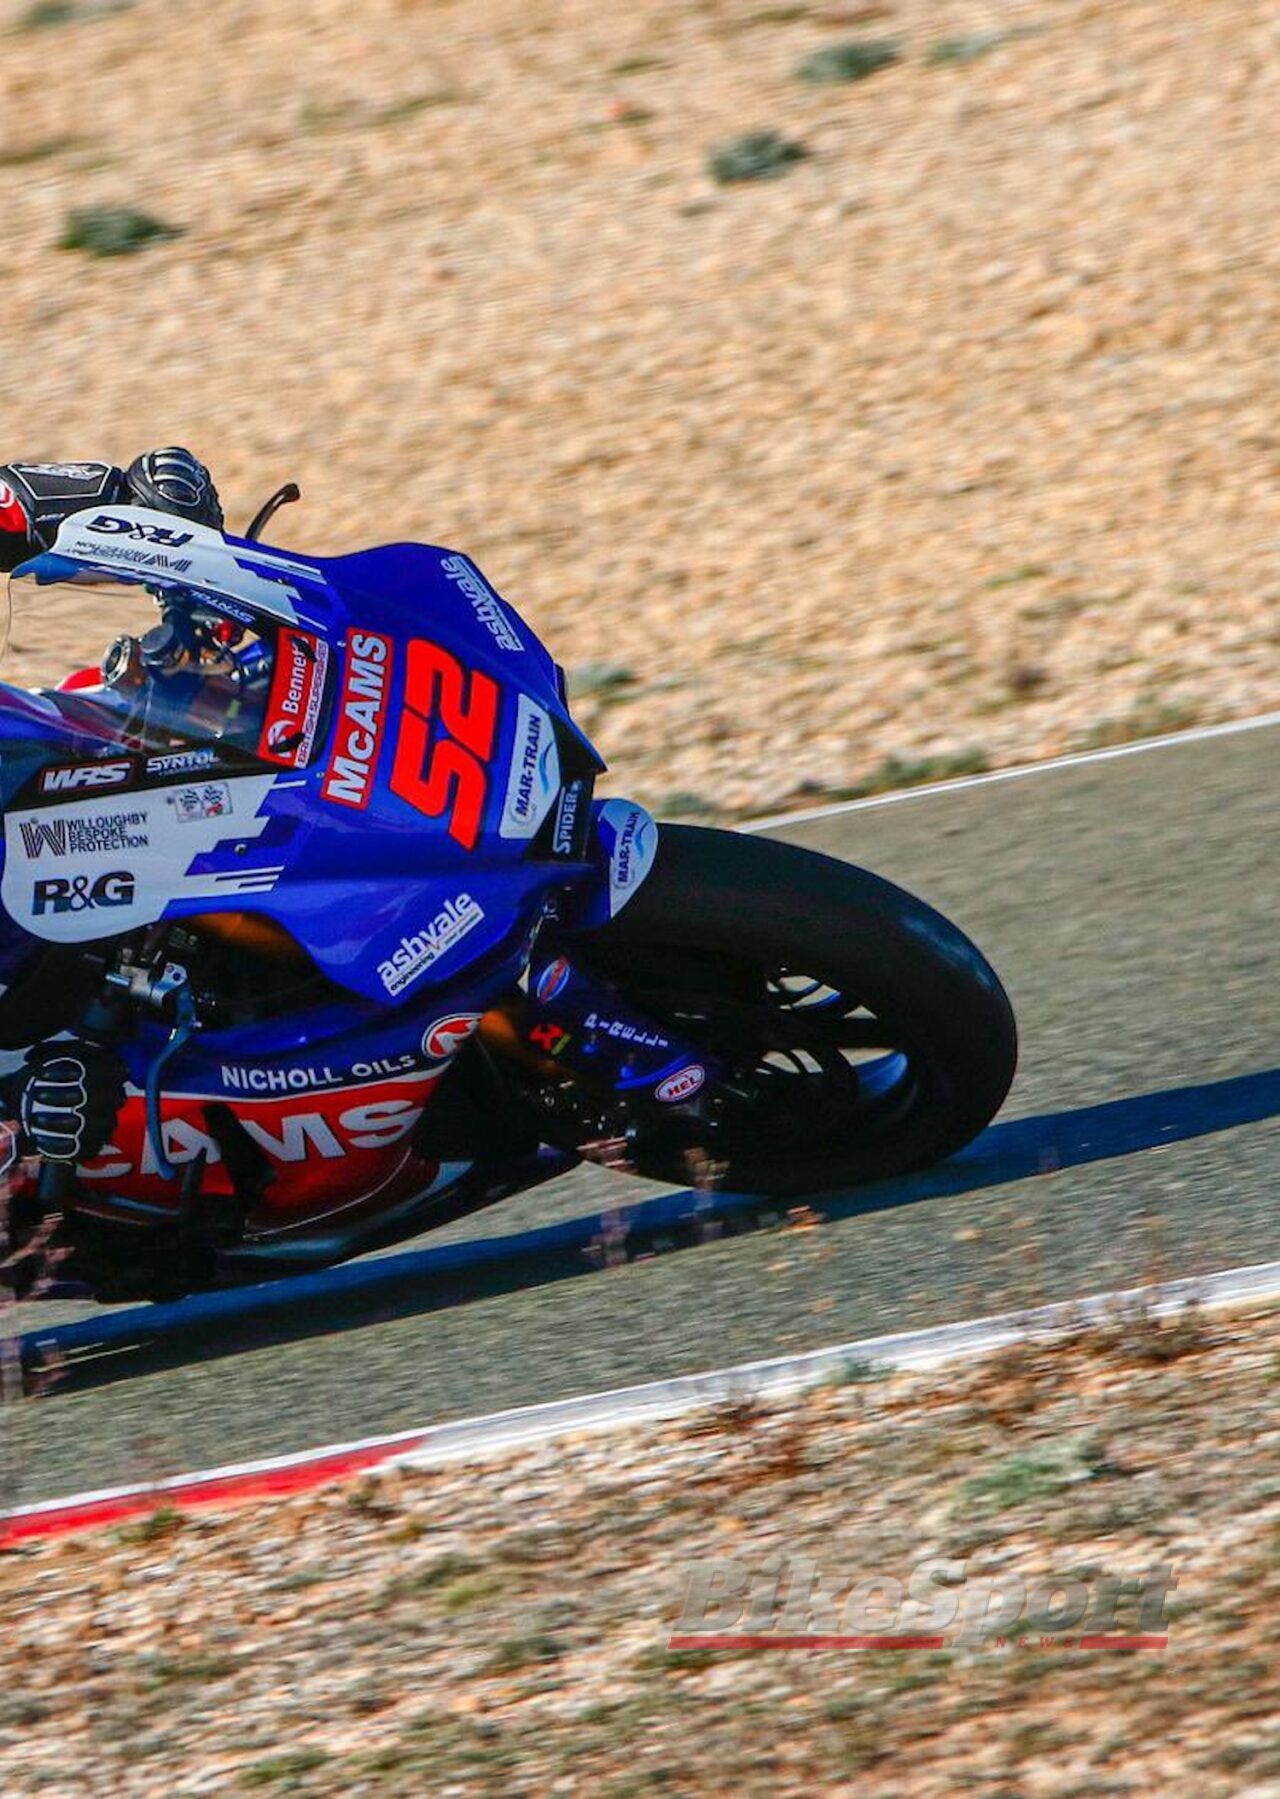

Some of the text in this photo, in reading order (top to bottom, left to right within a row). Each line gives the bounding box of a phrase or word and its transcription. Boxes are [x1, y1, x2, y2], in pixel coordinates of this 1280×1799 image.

[85, 514, 195, 548] R&G
[440, 557, 518, 650] ashvale
[282, 637, 310, 715] Bennet
[327, 634, 387, 803] McAMS
[145, 749, 220, 773] SYNTOL
[389, 638, 499, 852] 52
[515, 714, 542, 816] MAR-TRAIN
[43, 762, 131, 791] WRS
[67, 813, 148, 830] WILLOUGHBY
[69, 827, 127, 843] BESPOKE
[553, 786, 577, 853] SPIDER
[70, 835, 150, 855] PROTECTION
[618, 811, 641, 883] MAR-TRAIN
[31, 870, 136, 916] R&G
[377, 892, 472, 984] ashvale
[390, 951, 436, 993] engineering
[584, 1012, 669, 1048] PIRELLI
[221, 1054, 416, 1091] NICHOLL OILS
[668, 1076, 698, 1097] HEL
